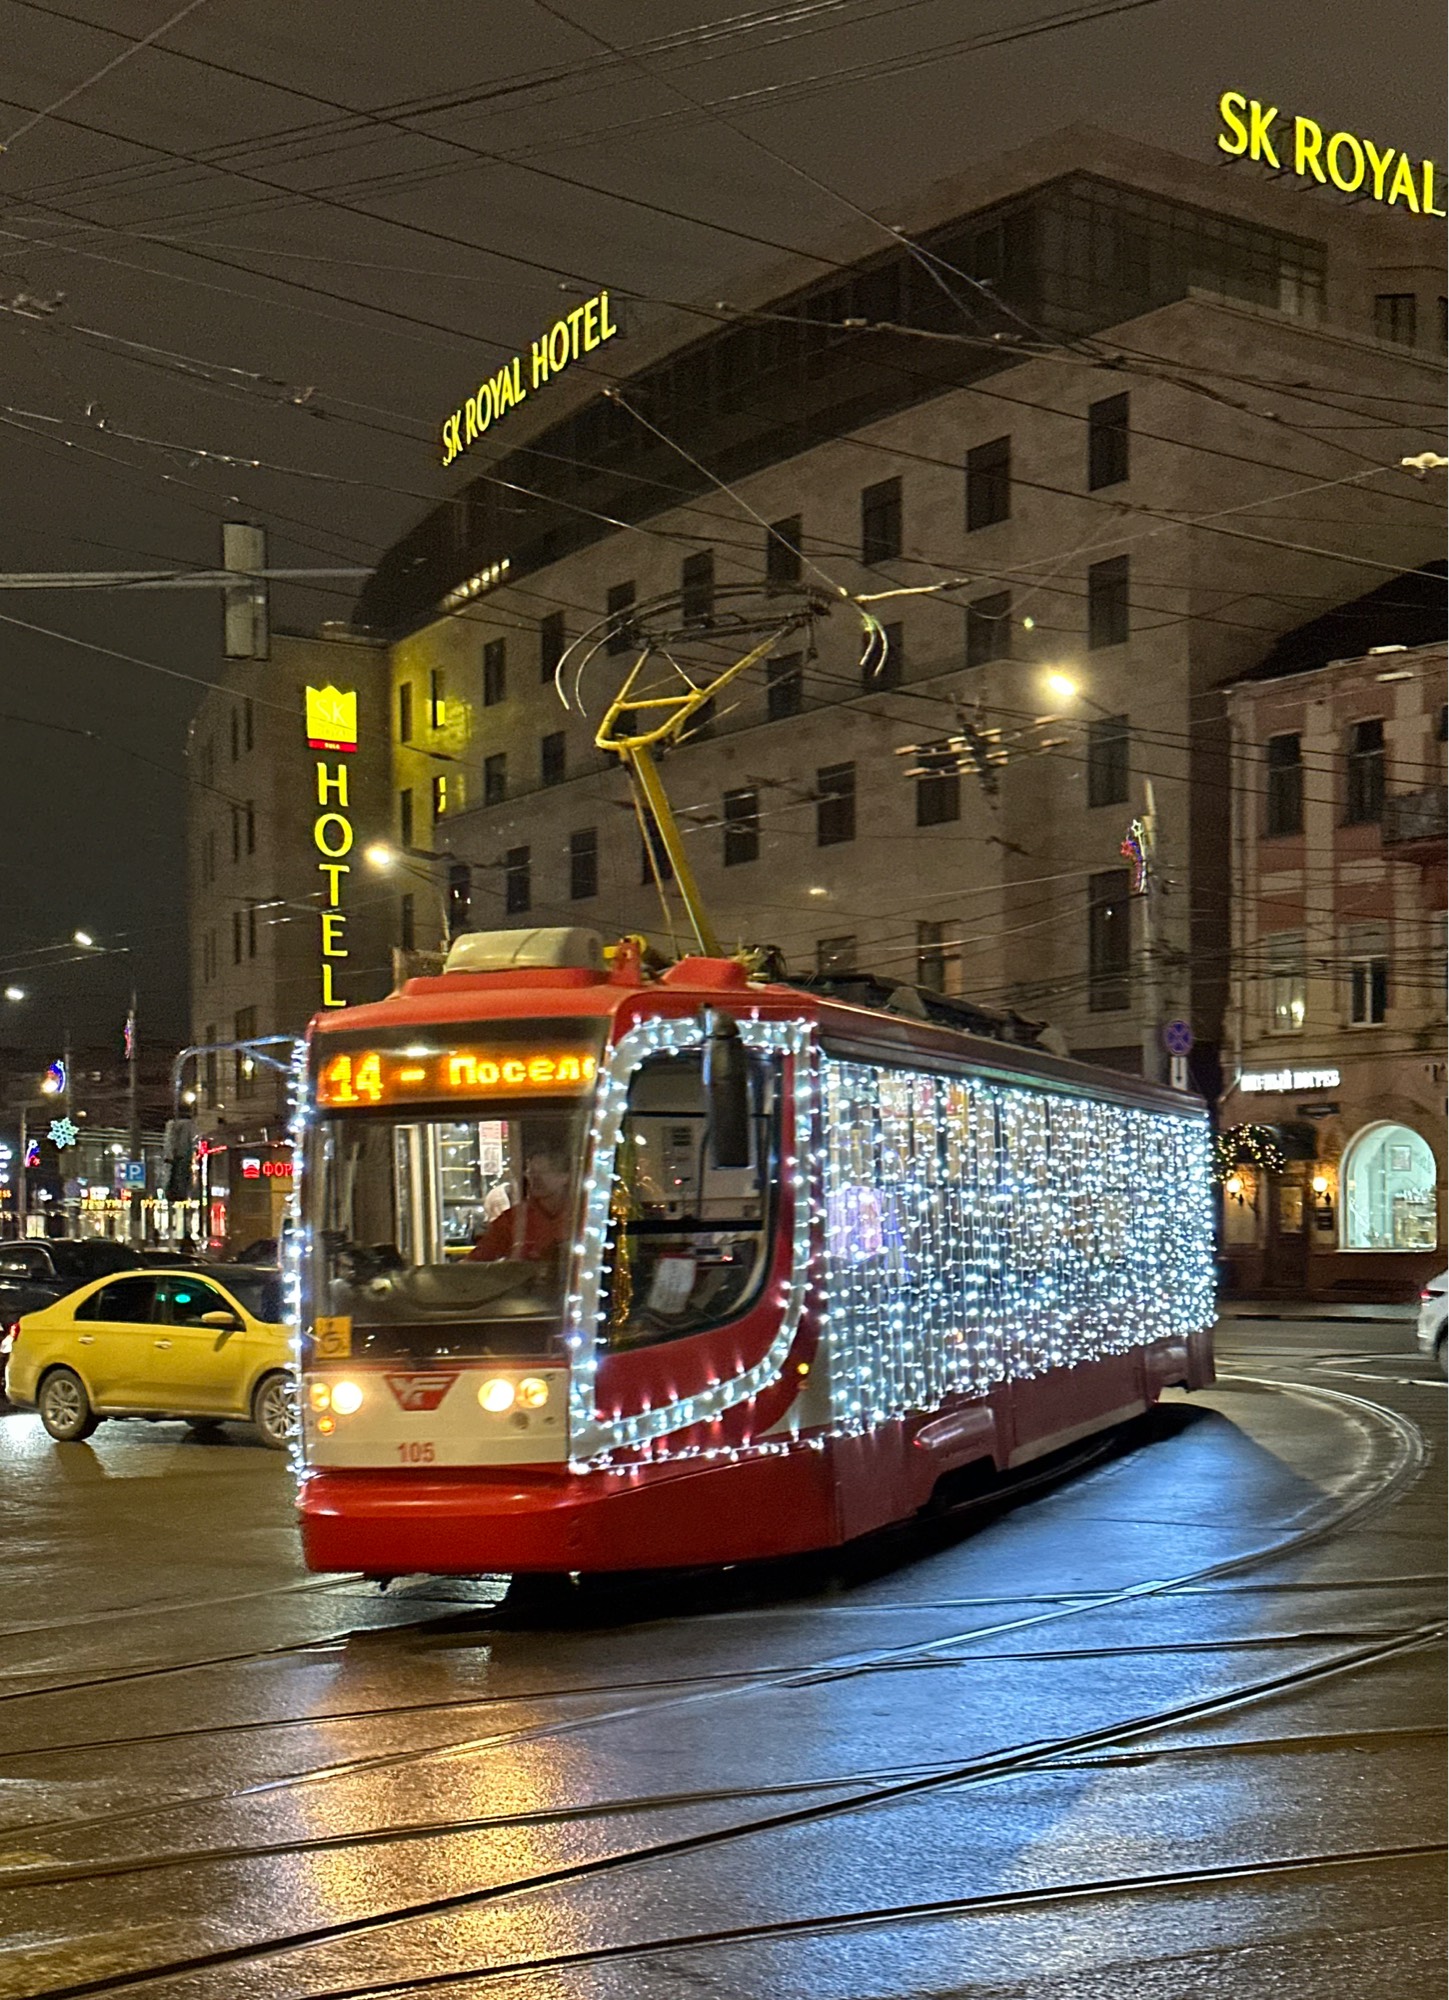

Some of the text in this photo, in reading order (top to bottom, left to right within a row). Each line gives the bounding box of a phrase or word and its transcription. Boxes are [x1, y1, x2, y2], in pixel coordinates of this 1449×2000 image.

[1218, 91, 1447, 217] SK ROYAL
[442, 290, 617, 467] SK ROYAL HOTEL
[315, 698, 350, 727] SK
[314, 762, 354, 1007] HOTEL
[330, 1052, 383, 1101] 14
[262, 1160, 294, 1177] ФОР
[397, 1442, 436, 1463] 105
